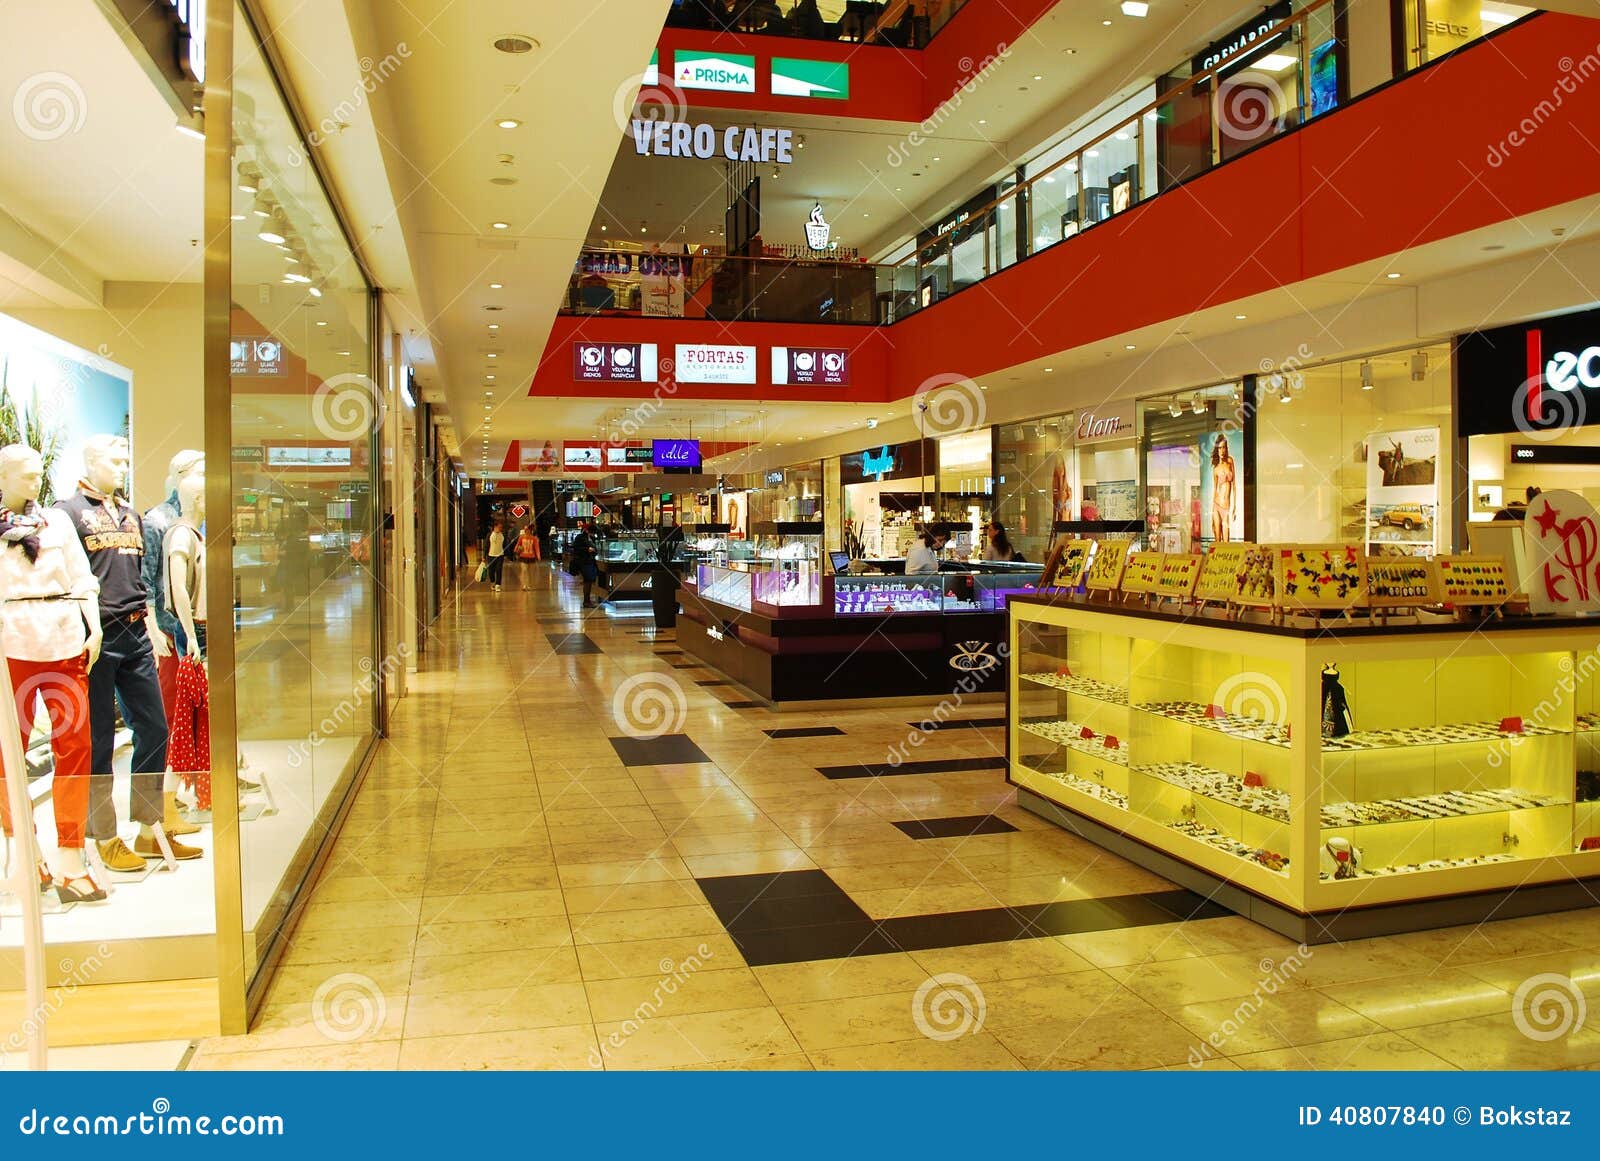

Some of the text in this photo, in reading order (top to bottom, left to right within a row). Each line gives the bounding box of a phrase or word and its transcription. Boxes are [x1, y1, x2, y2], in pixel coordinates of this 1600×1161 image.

[695, 68, 750, 85] PRISMA
[631, 119, 793, 164] VERO CAFE
[687, 349, 745, 364] FORTAS
[1517, 449, 1535, 458] ecco
